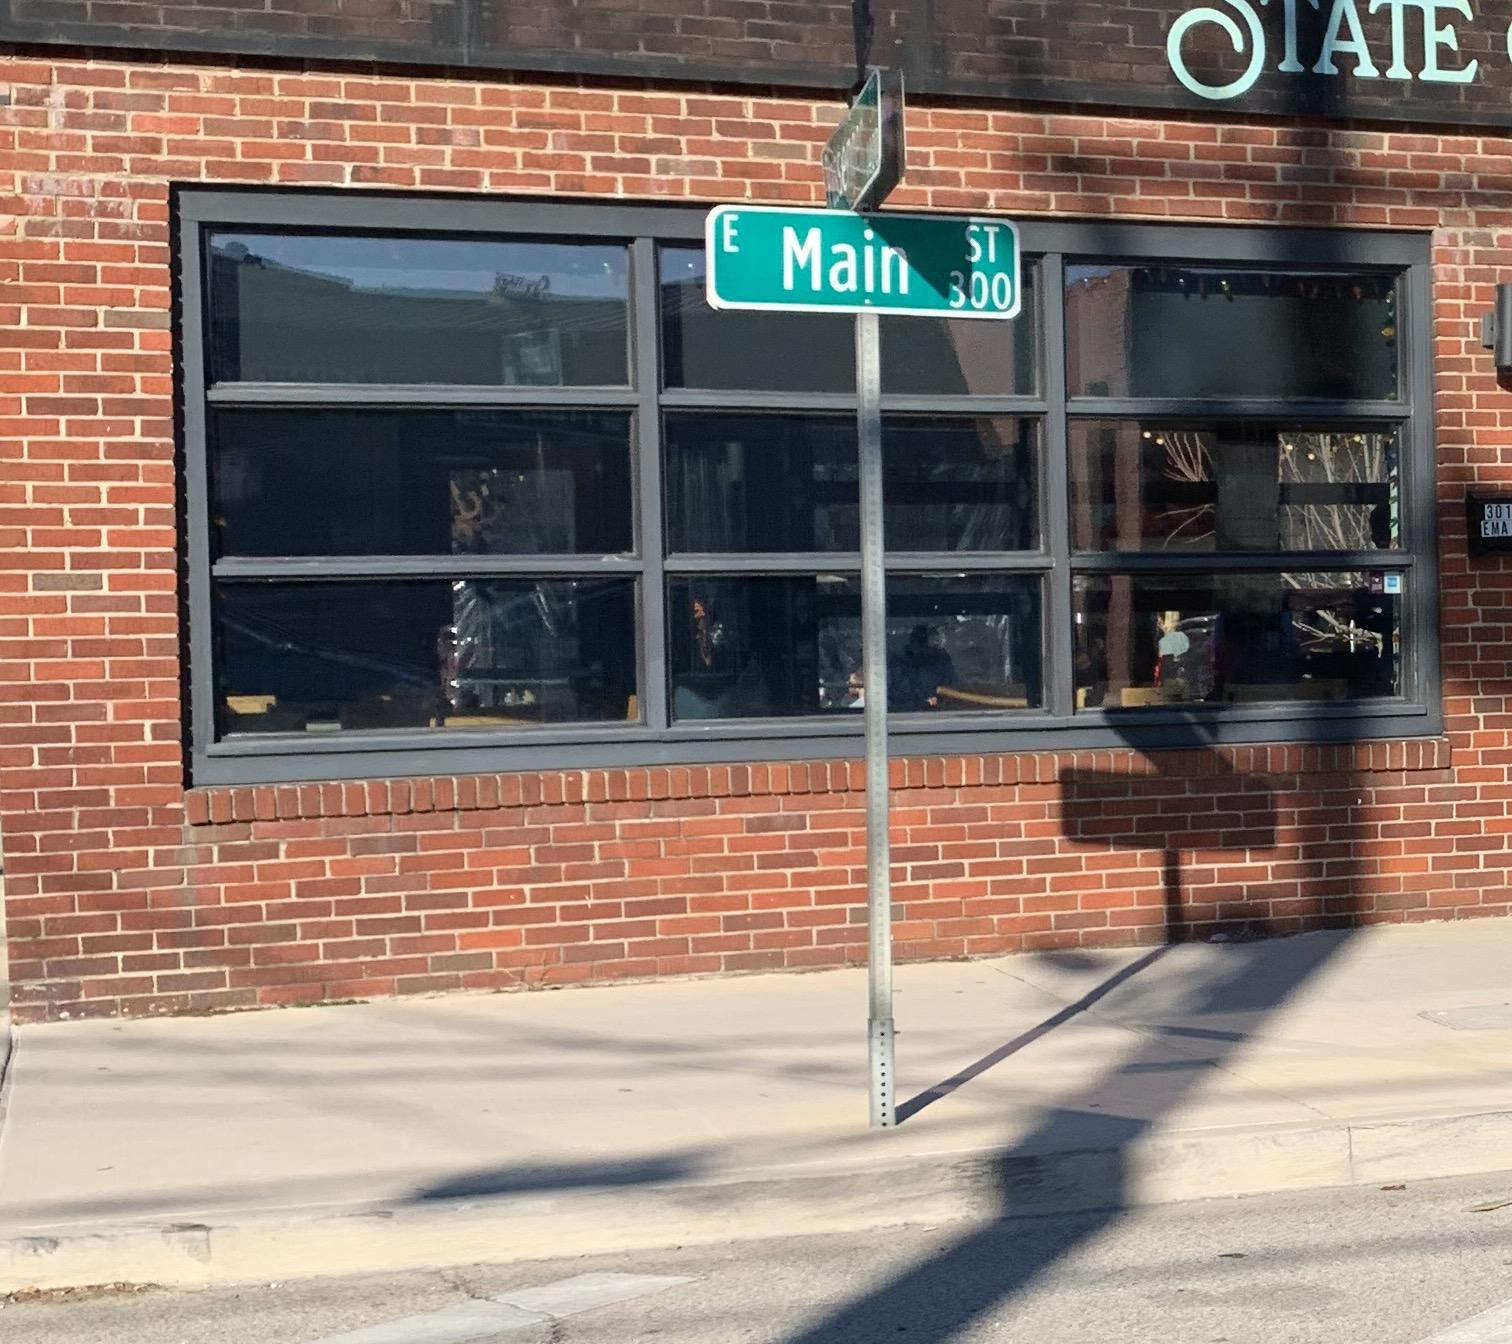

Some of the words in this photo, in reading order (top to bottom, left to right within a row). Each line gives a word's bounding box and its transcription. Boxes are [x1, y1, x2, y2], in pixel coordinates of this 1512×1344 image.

[722, 214, 740, 253] E
[782, 226, 909, 295] Main
[965, 225, 1000, 264] ST
[949, 269, 1012, 310] 300
[1486, 504, 1511, 519] 301
